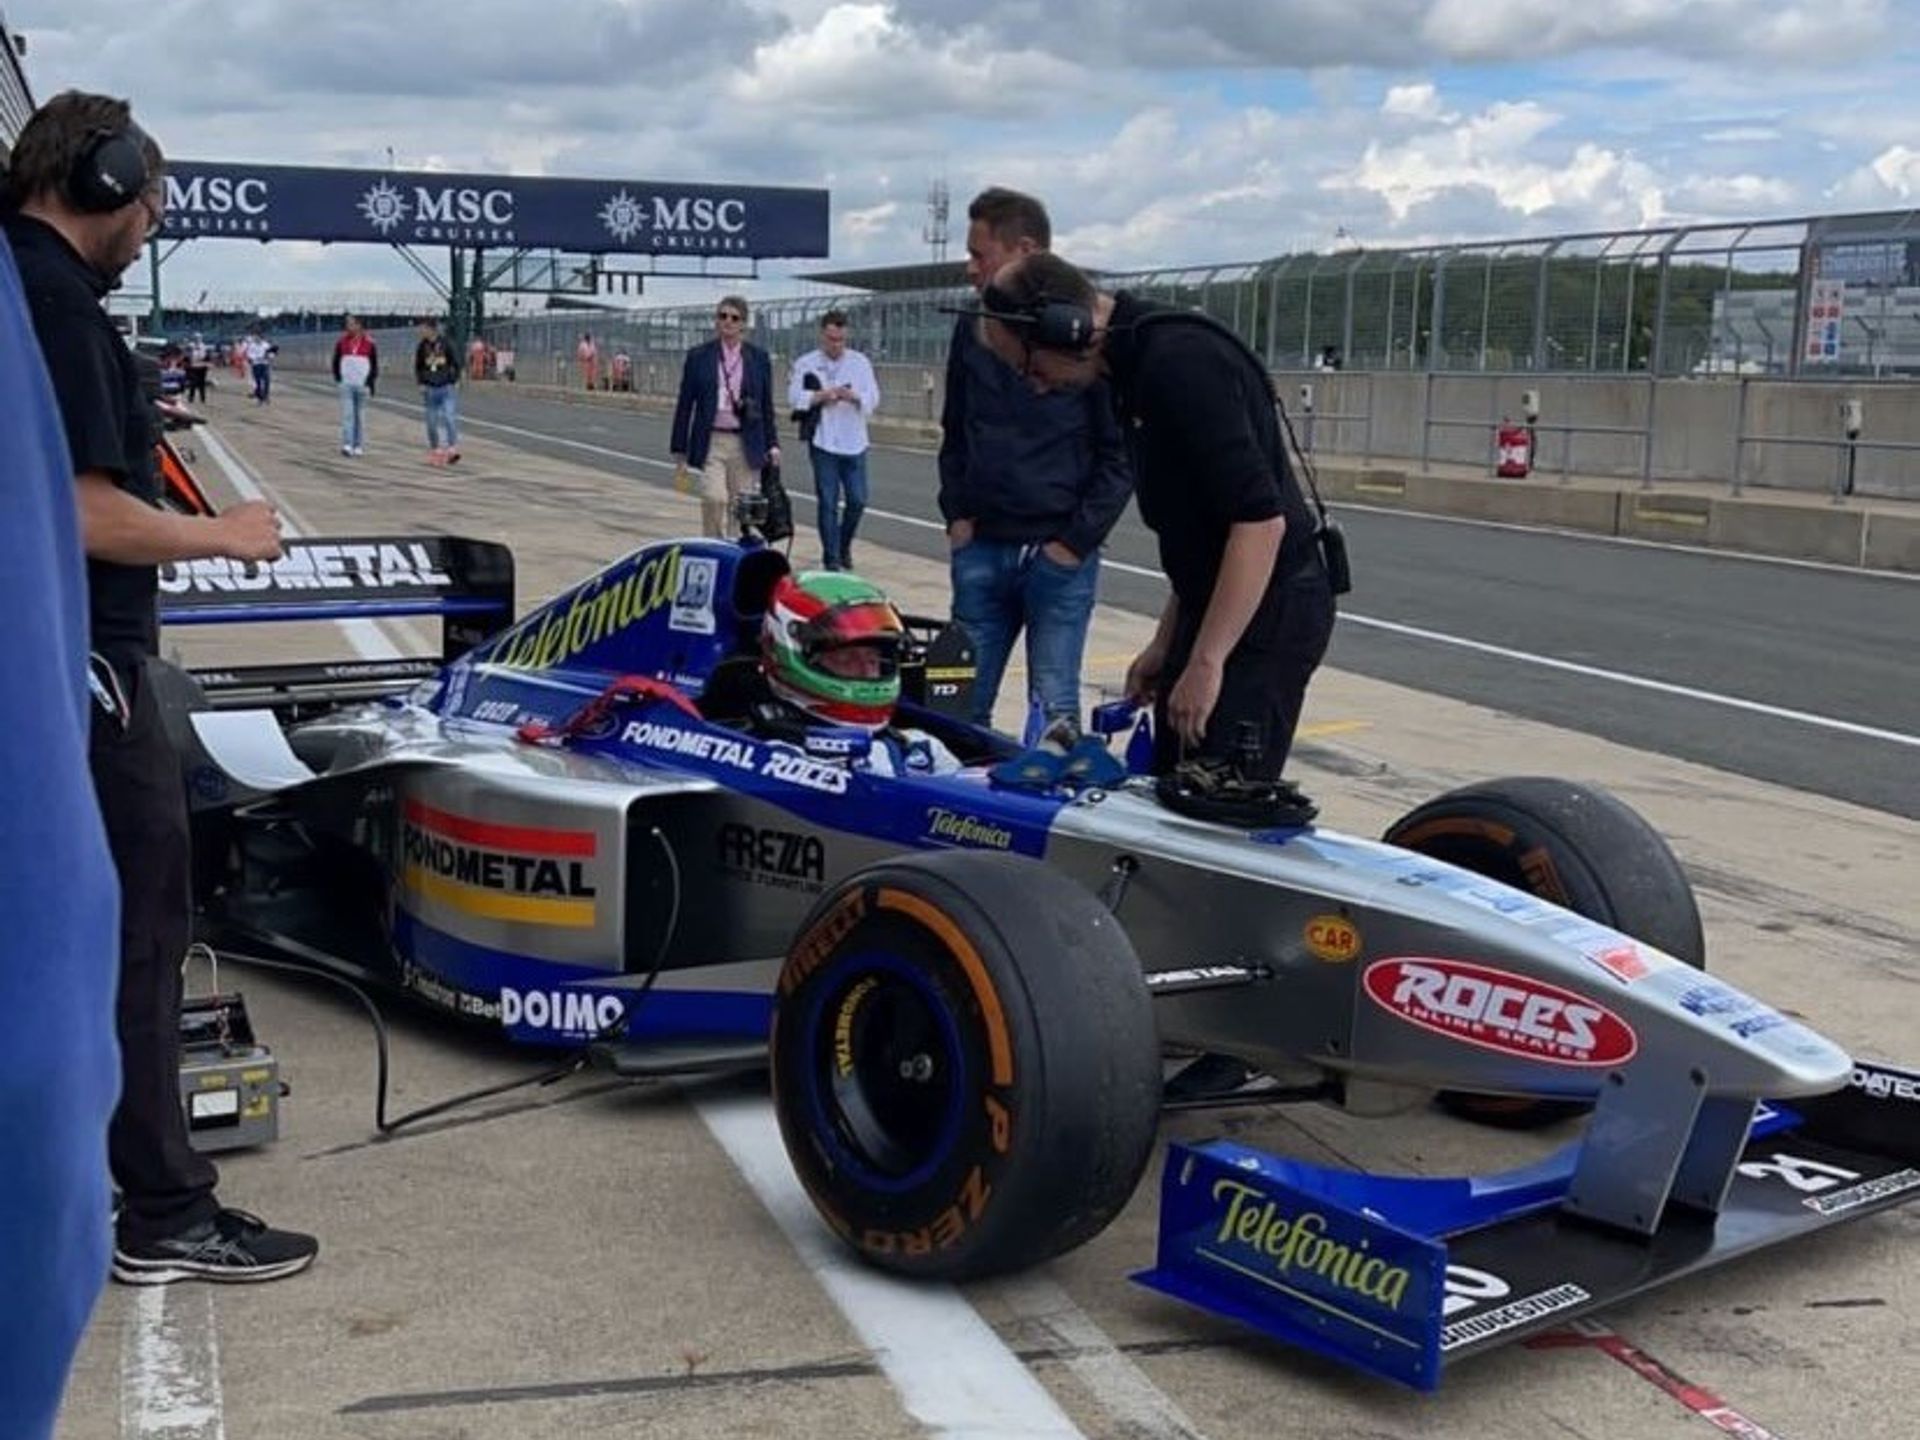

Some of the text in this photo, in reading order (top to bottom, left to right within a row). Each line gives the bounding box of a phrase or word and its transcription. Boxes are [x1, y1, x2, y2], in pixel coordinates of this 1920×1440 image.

[165, 175, 269, 214] MSC
[414, 186, 514, 224] MSC
[164, 216, 270, 232] CRUISES
[414, 225, 516, 242] CRUISES
[652, 196, 746, 233] MSC
[652, 235, 747, 250] CRUISES
[158, 543, 451, 592] ONDMETAL
[621, 721, 853, 794] FONDMETAL ROCES
[1309, 925, 1354, 952] CAR
[501, 986, 625, 1031] DOIMO
[1393, 963, 1604, 1052] ROCES
[1404, 1005, 1590, 1060] INLINE SKATES
